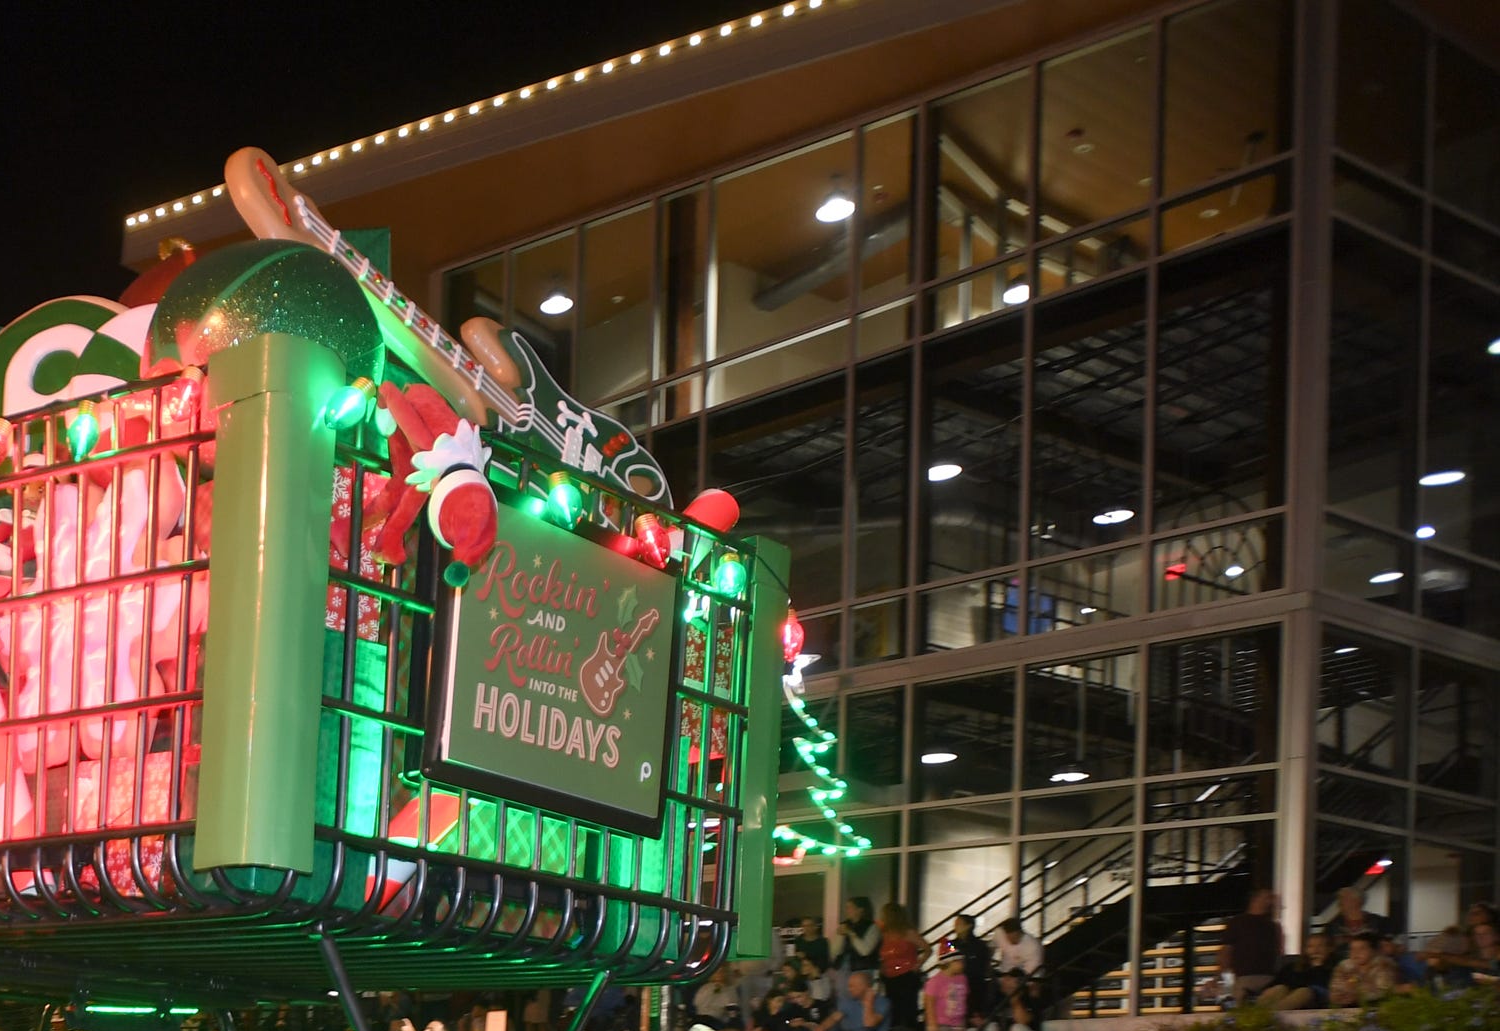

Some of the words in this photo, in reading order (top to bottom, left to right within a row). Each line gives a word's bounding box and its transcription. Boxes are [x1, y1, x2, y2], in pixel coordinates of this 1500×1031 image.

[475, 541, 611, 619] Rockin'
[527, 609, 566, 632] AND
[484, 623, 580, 688] Rollin'
[528, 677, 556, 697] INTO
[558, 685, 579, 703] THE
[472, 682, 623, 769] HOLIDAYS
